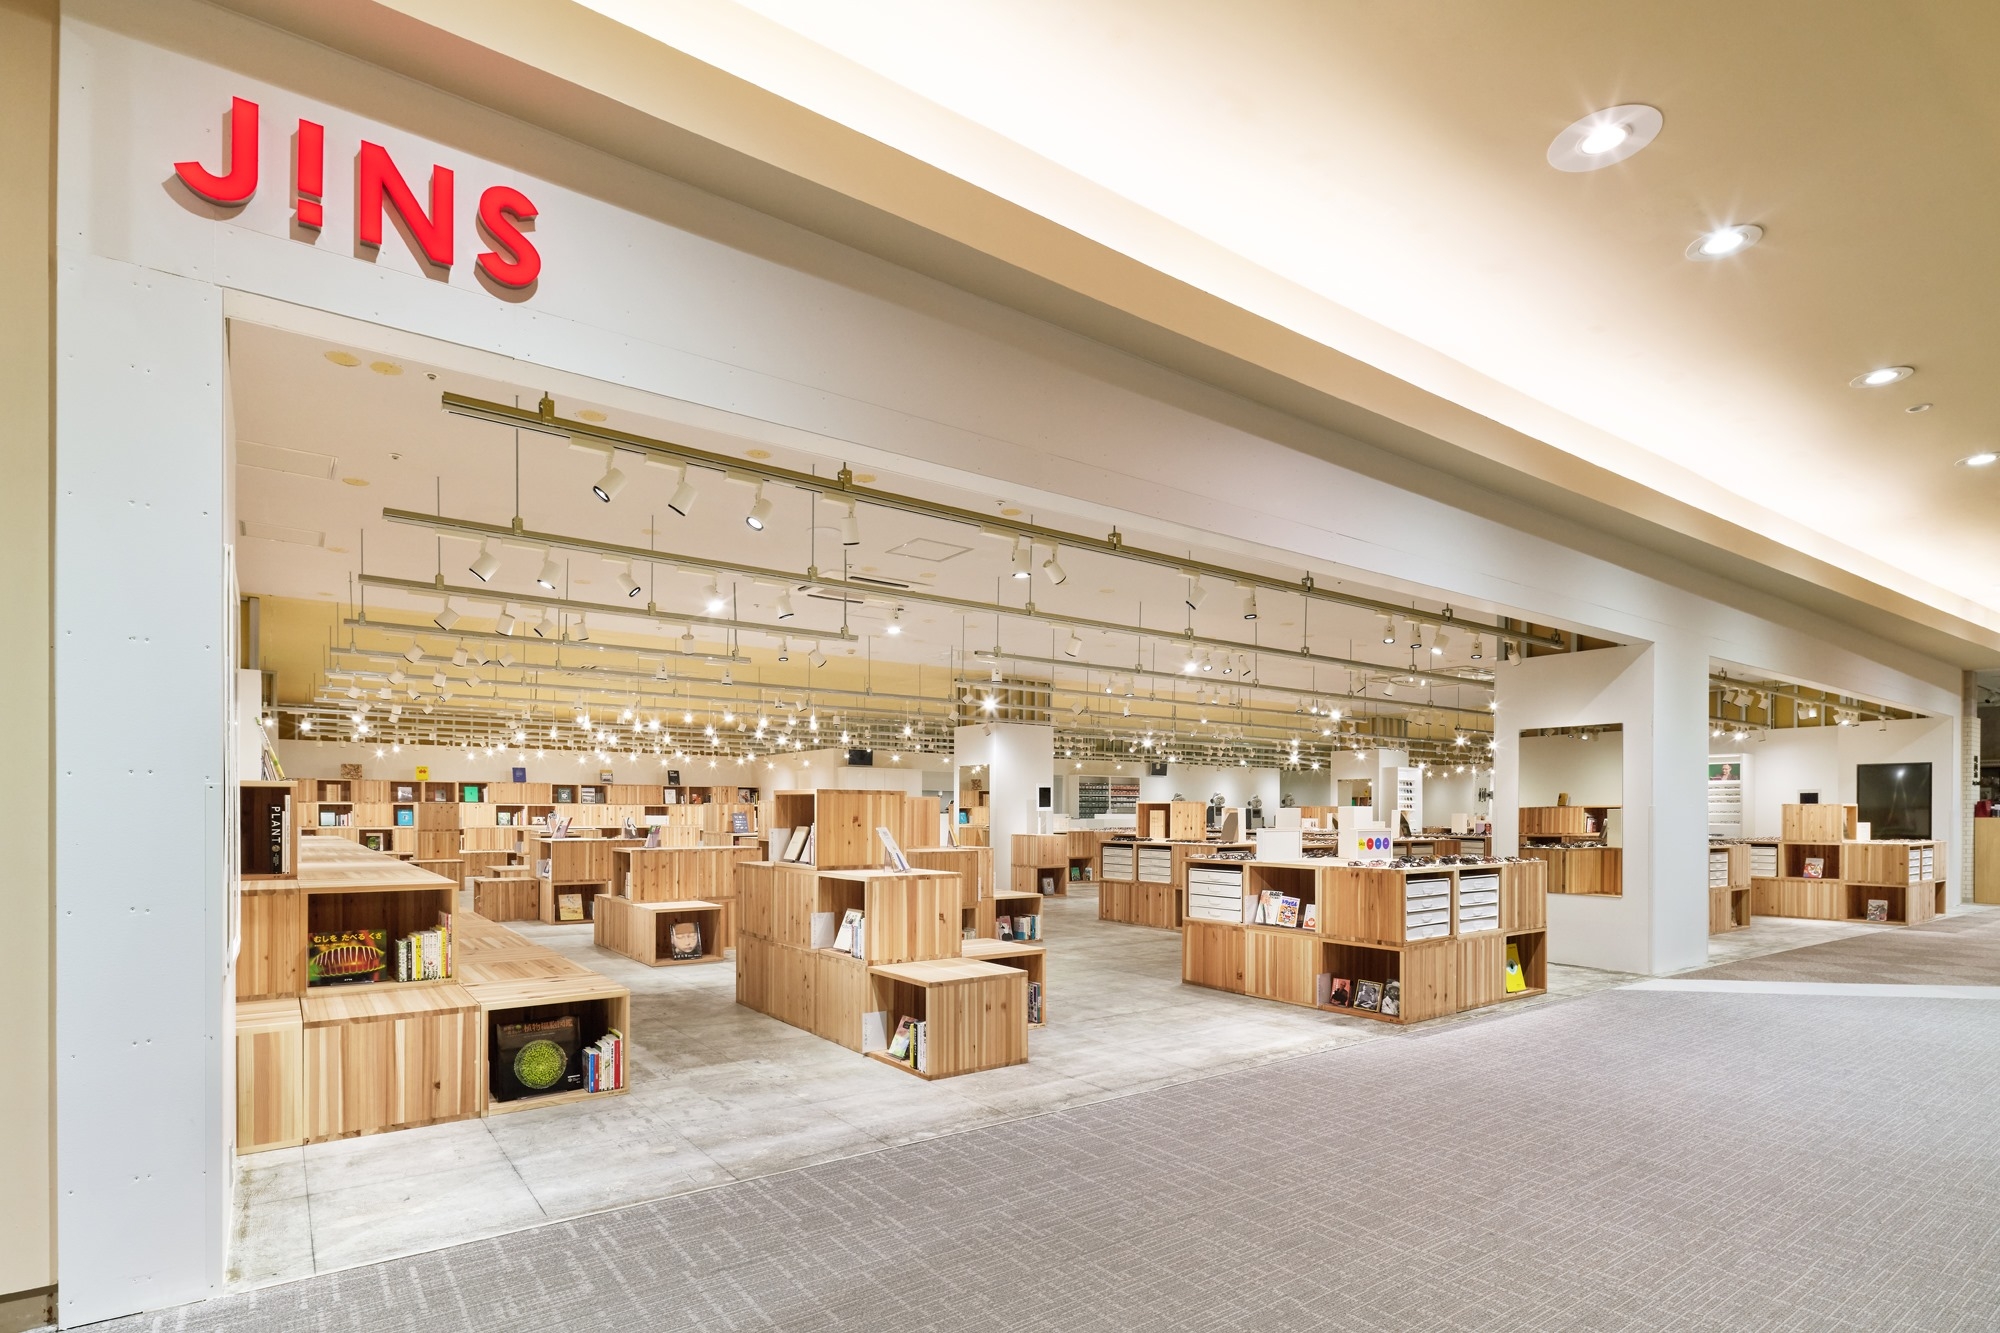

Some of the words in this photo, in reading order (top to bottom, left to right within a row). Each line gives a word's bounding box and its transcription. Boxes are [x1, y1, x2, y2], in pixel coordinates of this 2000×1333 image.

[272, 806, 280, 843] PLANT
[314, 935, 337, 943] むしを
[342, 934, 365, 942] たべる
